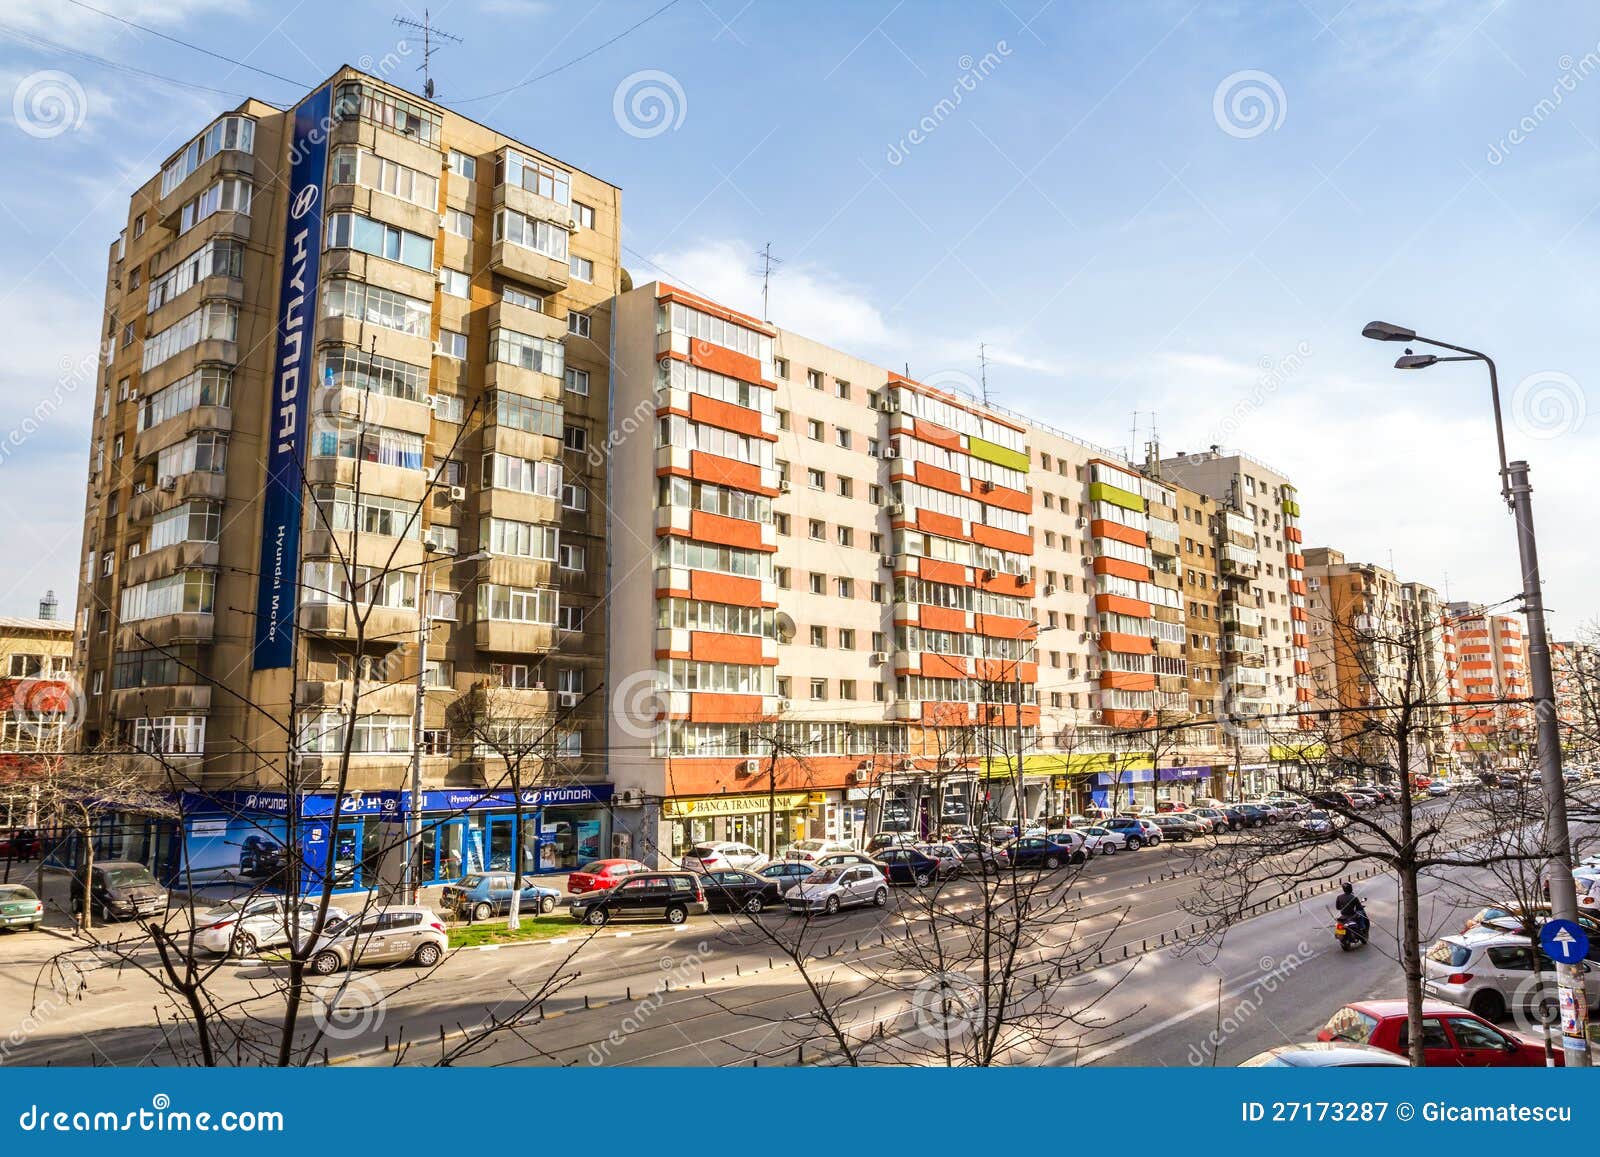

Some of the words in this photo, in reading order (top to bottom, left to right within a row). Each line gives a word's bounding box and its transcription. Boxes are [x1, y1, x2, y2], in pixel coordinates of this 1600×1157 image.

[278, 228, 308, 454] HYUNDAI
[273, 525, 286, 590] Hyundai
[268, 595, 280, 643] Motor
[451, 794, 479, 804] Hyundai
[544, 790, 591, 801] HYUNDAI
[258, 797, 289, 811] HYUNDA
[697, 800, 729, 812] BANCA
